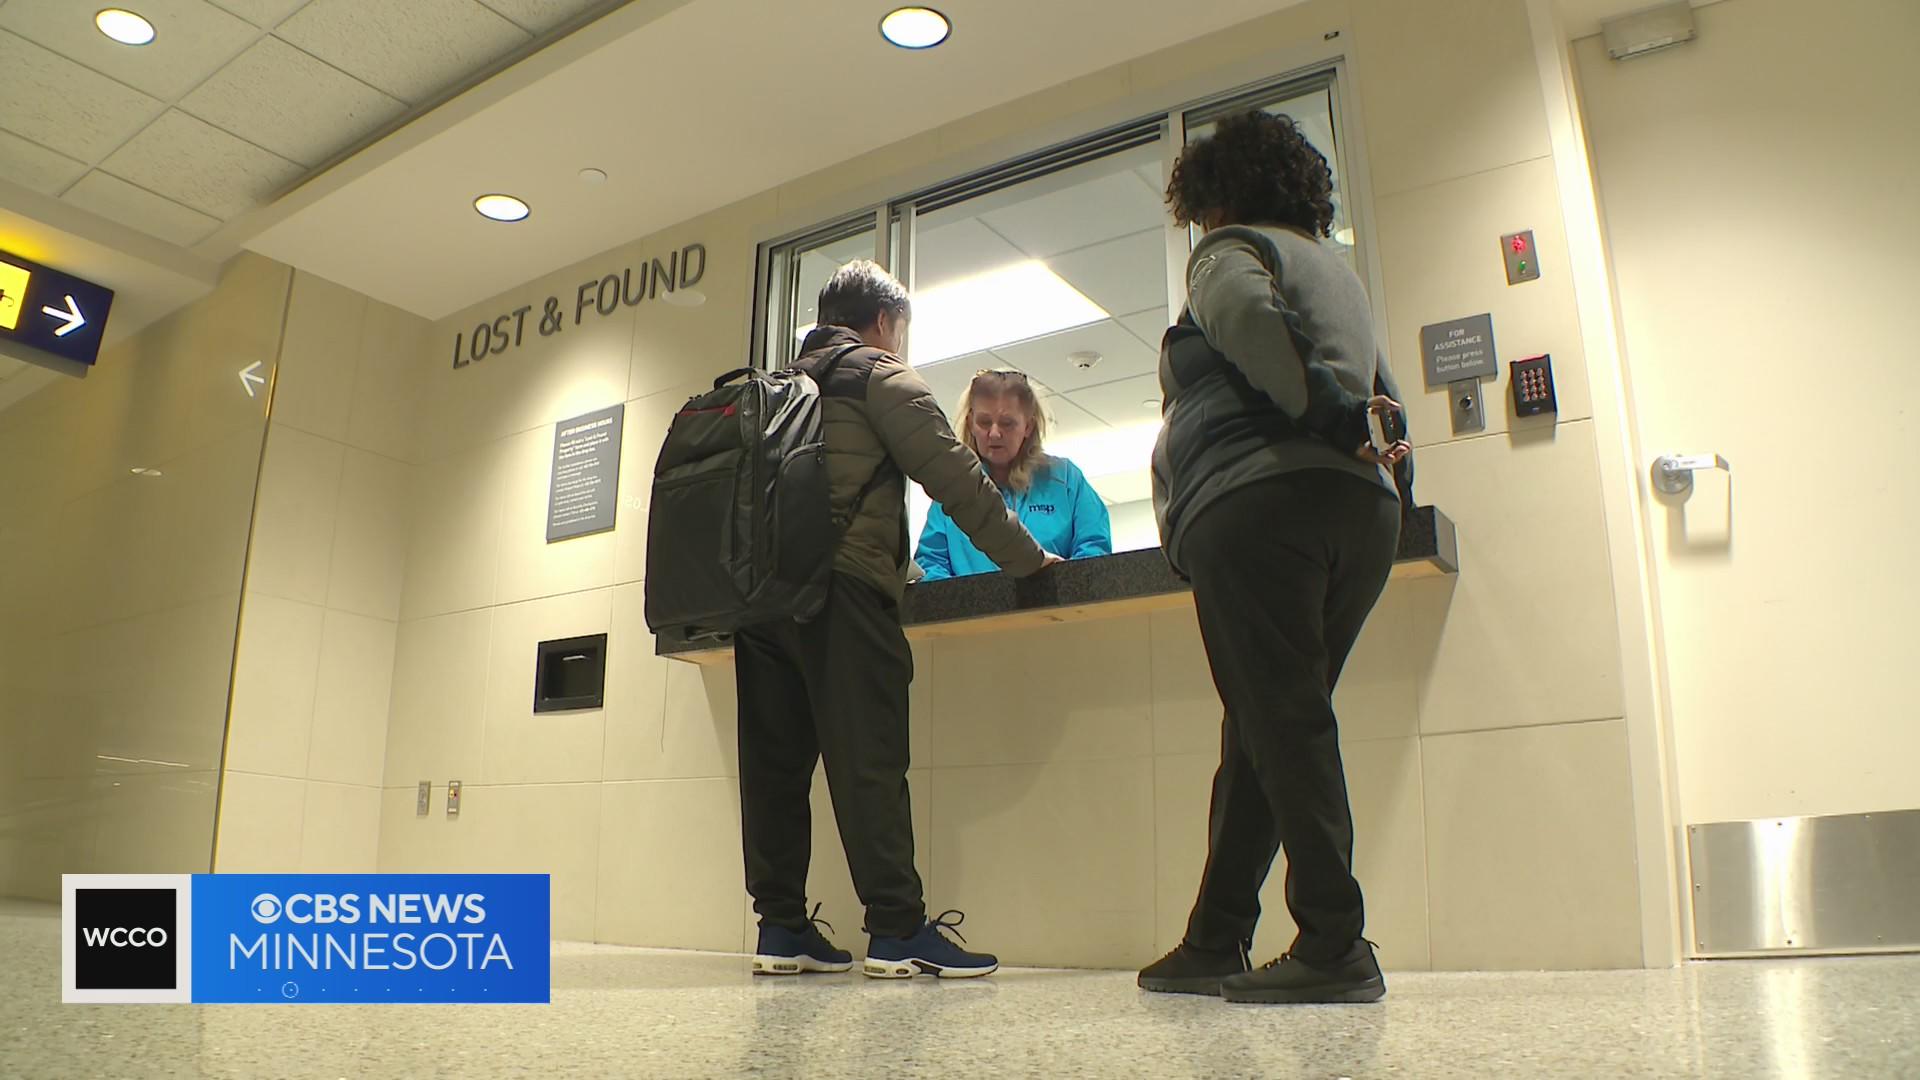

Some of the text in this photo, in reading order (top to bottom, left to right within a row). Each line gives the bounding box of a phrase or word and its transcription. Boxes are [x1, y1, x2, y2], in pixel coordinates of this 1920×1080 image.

[453, 243, 706, 369] LOST & FOUND
[1448, 328, 1465, 338] FOR
[1434, 335, 1482, 351] ASSISTANCE
[1436, 350, 1483, 363] Please press
[1436, 363, 1460, 373] button
[1029, 504, 1055, 515] msp
